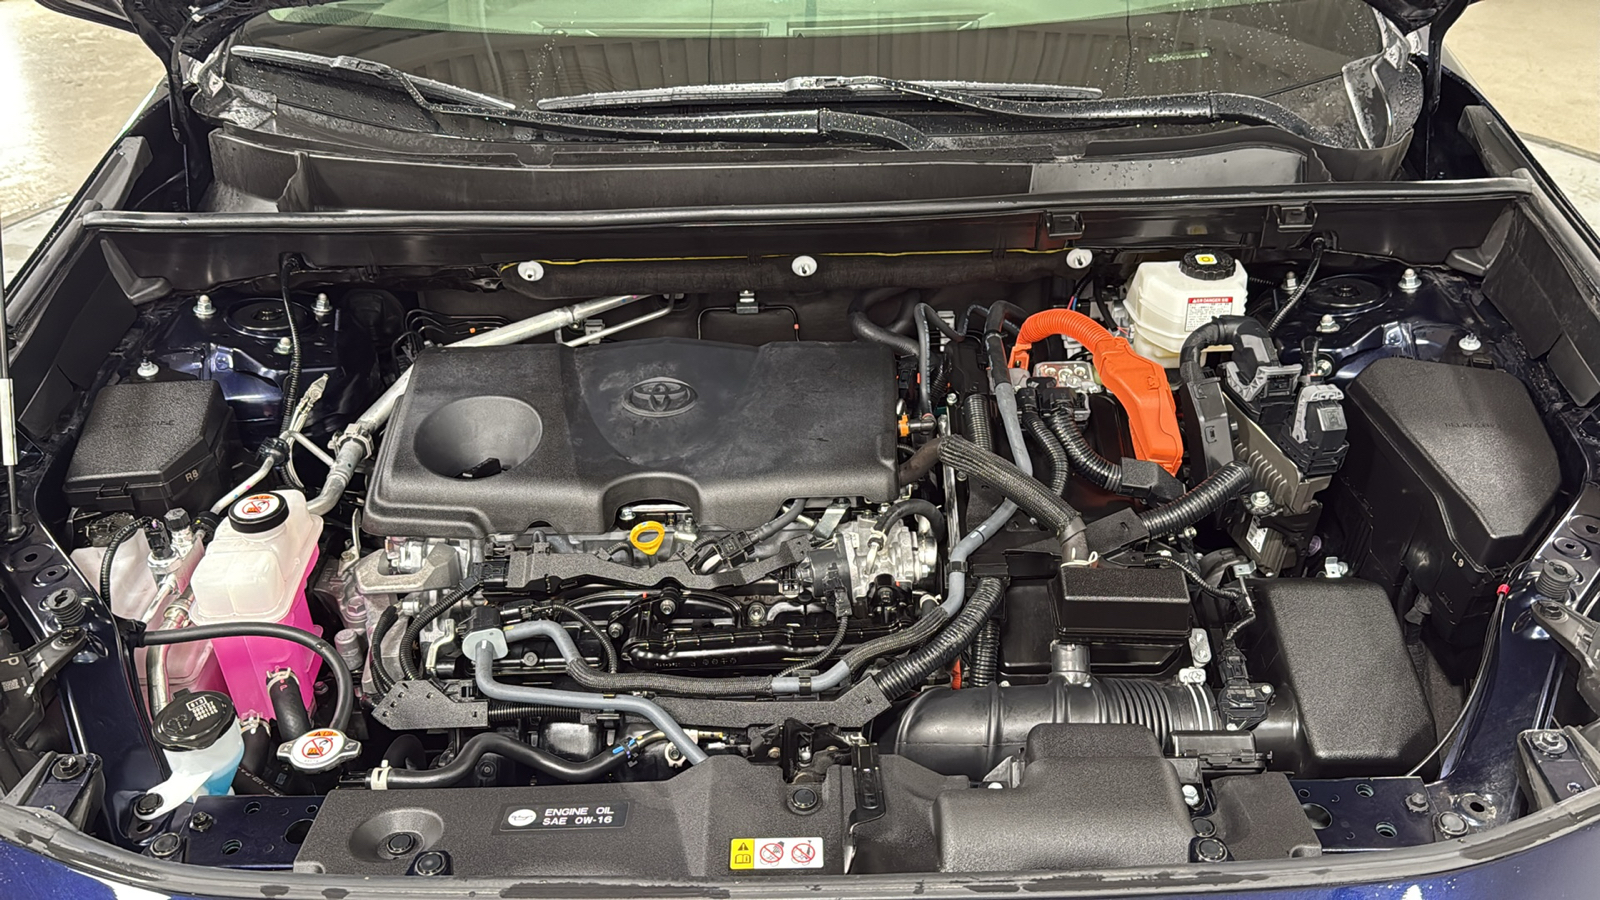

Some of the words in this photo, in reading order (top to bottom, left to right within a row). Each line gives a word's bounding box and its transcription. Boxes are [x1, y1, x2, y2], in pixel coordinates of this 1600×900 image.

[185, 469, 199, 482] R8
[544, 807, 589, 816] ENGINE
[596, 806, 614, 815] OIL
[542, 817, 567, 825] SAE
[574, 815, 613, 824] 0W-16
